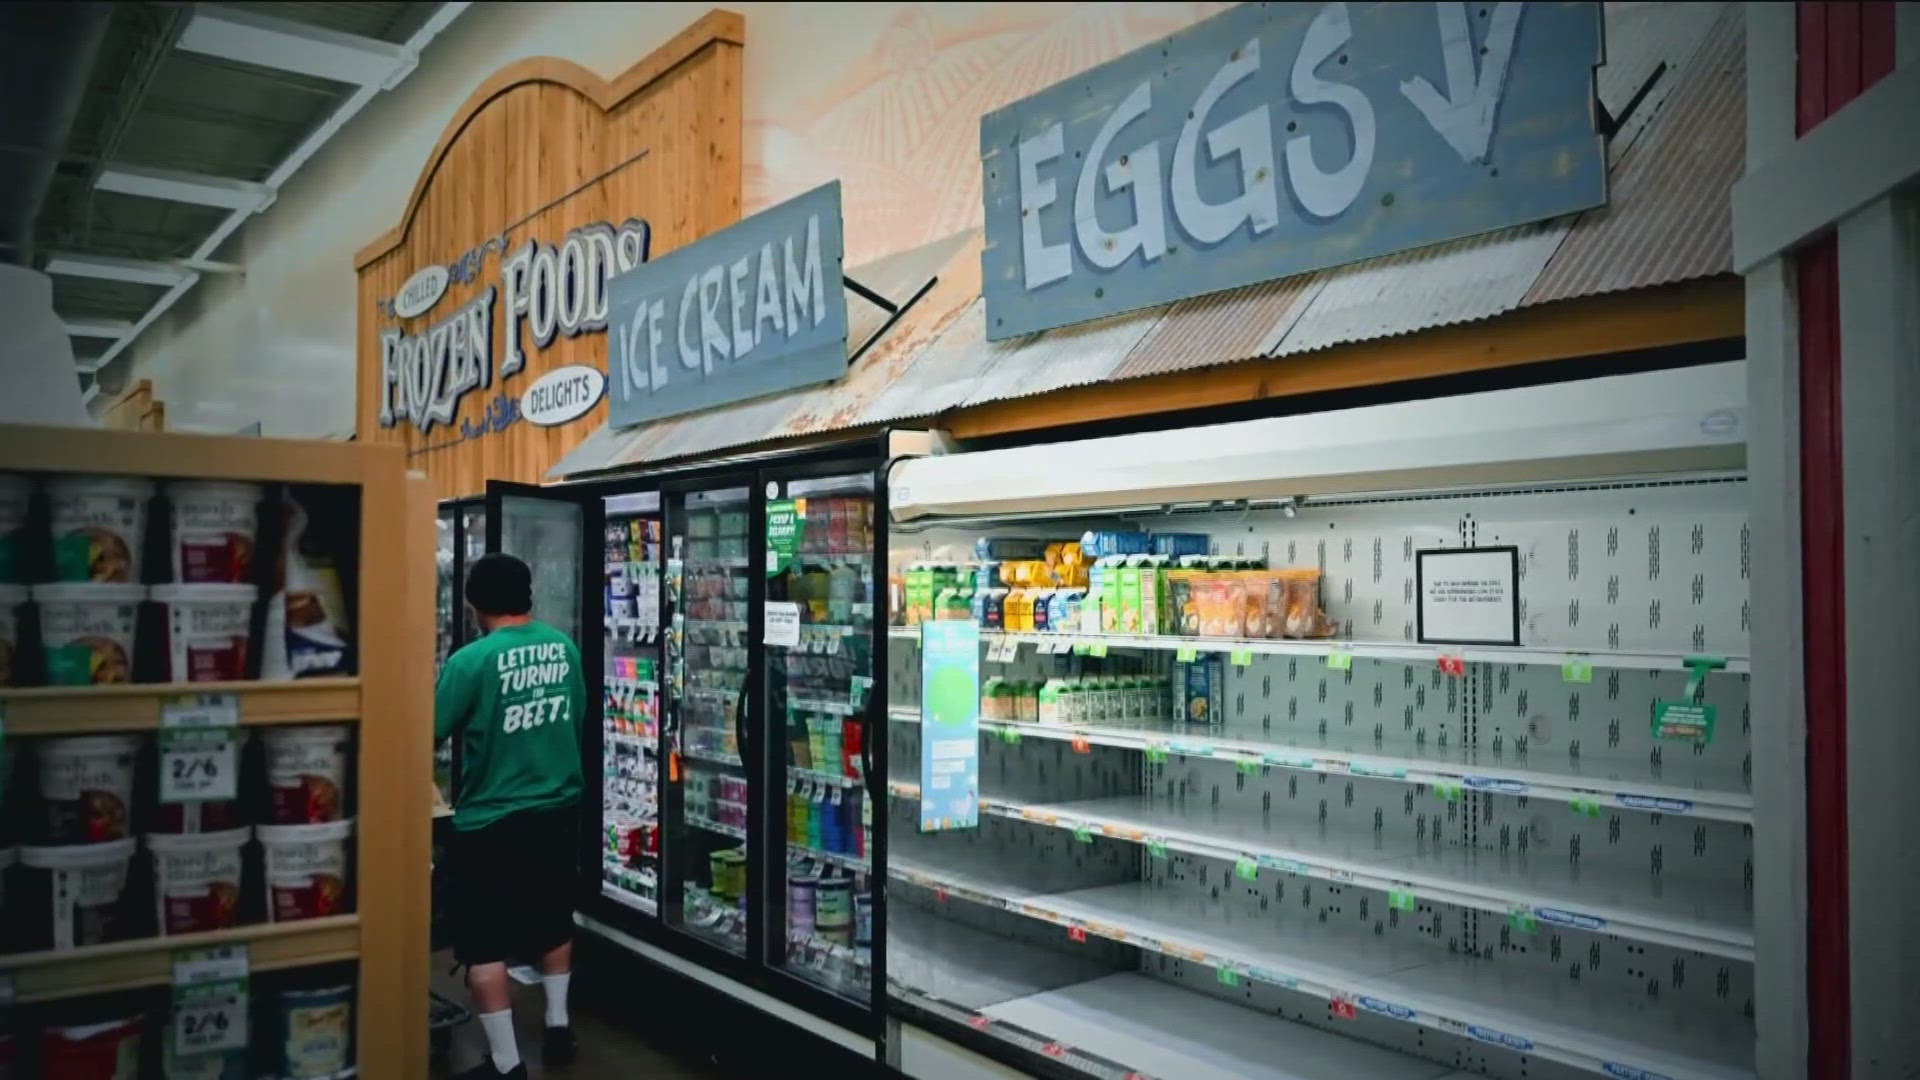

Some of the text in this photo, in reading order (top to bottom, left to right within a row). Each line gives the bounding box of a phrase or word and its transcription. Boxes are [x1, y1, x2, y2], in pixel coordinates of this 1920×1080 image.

[1016, 2, 1377, 291] EGGS
[403, 274, 438, 309] CHILLED
[619, 214, 826, 402] ICE CREAM
[379, 285, 497, 434] FROZEN
[530, 374, 590, 415] DELIGHTS
[497, 643, 566, 672] LETTUCE
[499, 661, 570, 695] TURNIP
[503, 694, 570, 734] BEET!
[173, 757, 218, 779] 2/6
[183, 1011, 229, 1034] 2/6
